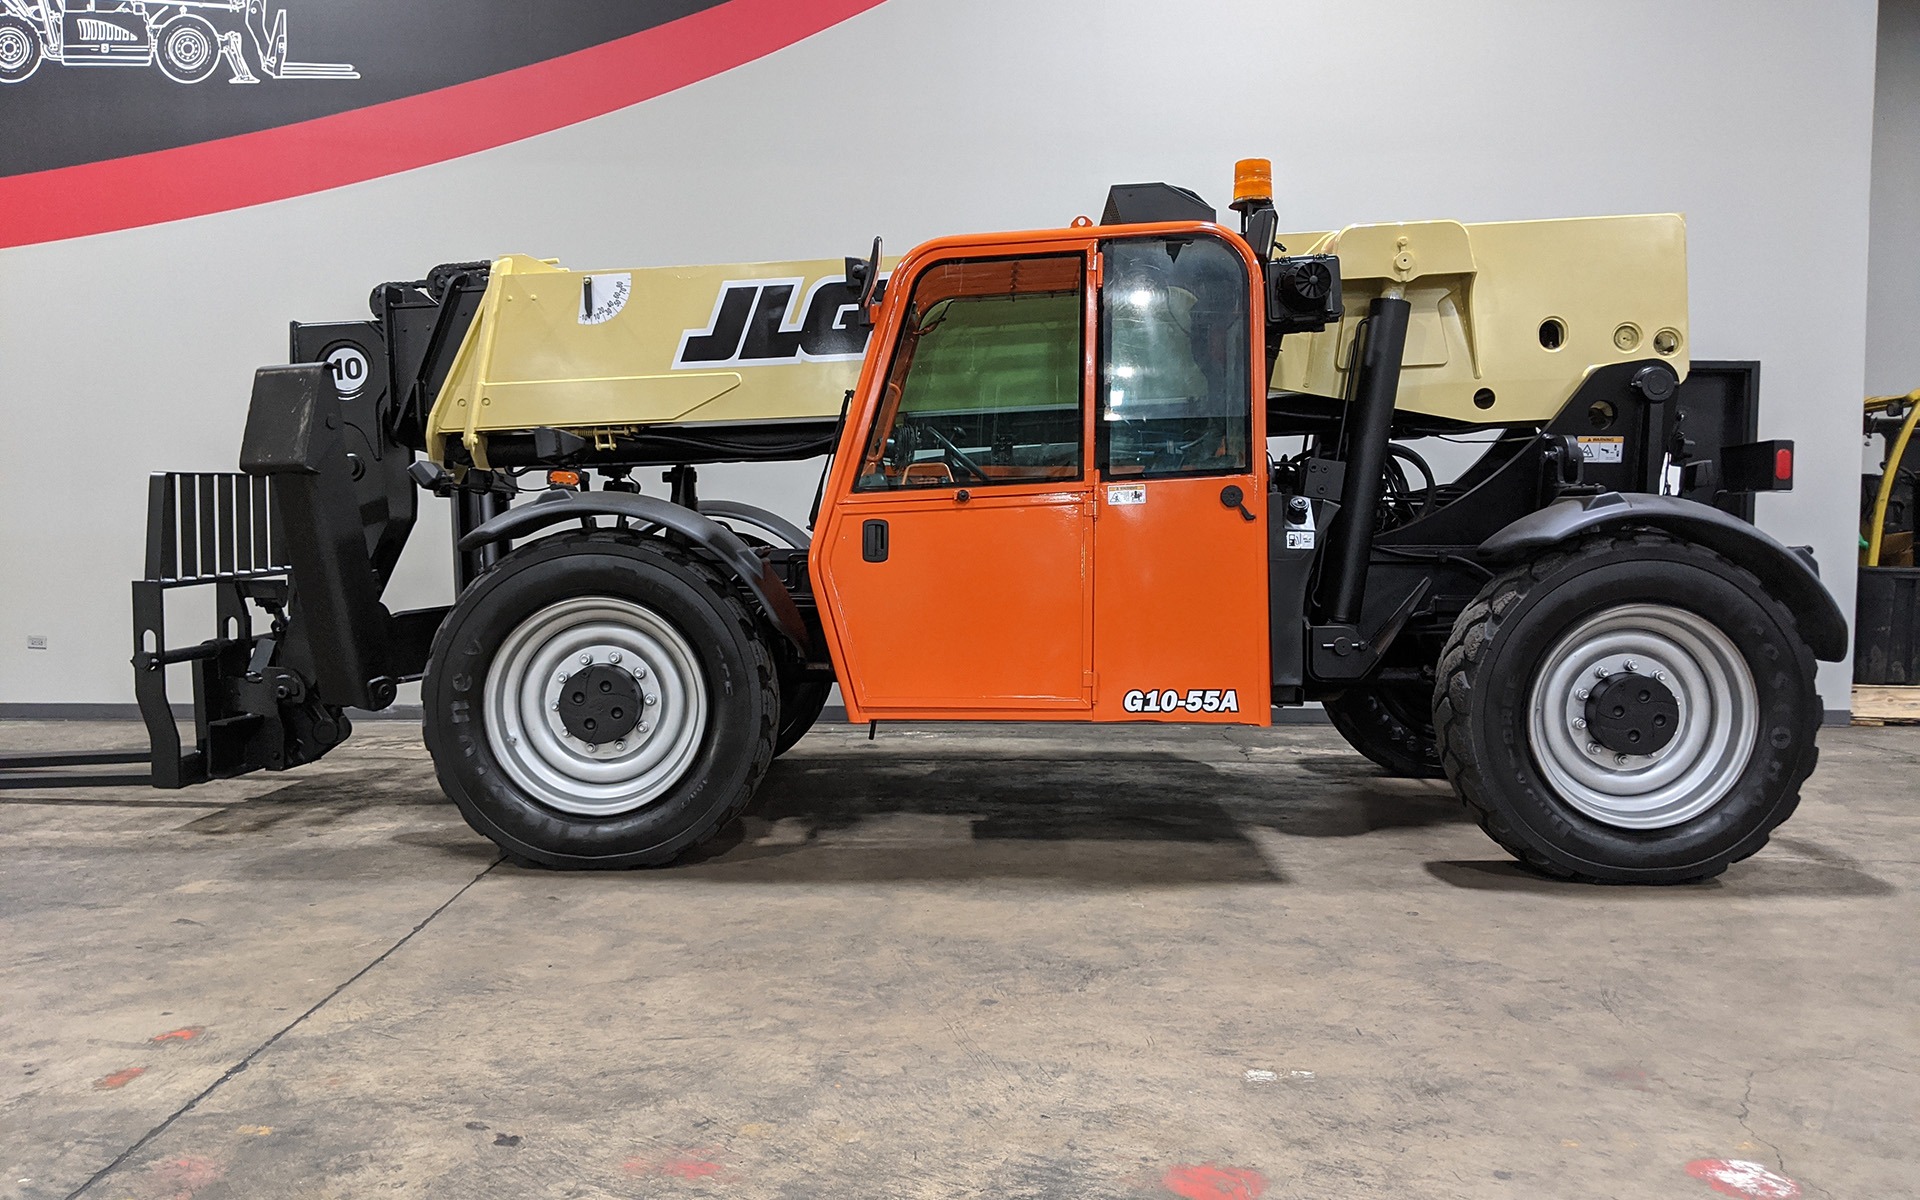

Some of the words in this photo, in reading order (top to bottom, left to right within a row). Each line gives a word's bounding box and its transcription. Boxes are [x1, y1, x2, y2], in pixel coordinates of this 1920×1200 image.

[678, 278, 888, 364] JLG
[332, 357, 363, 381] 10
[1123, 688, 1239, 713] G10-55A
